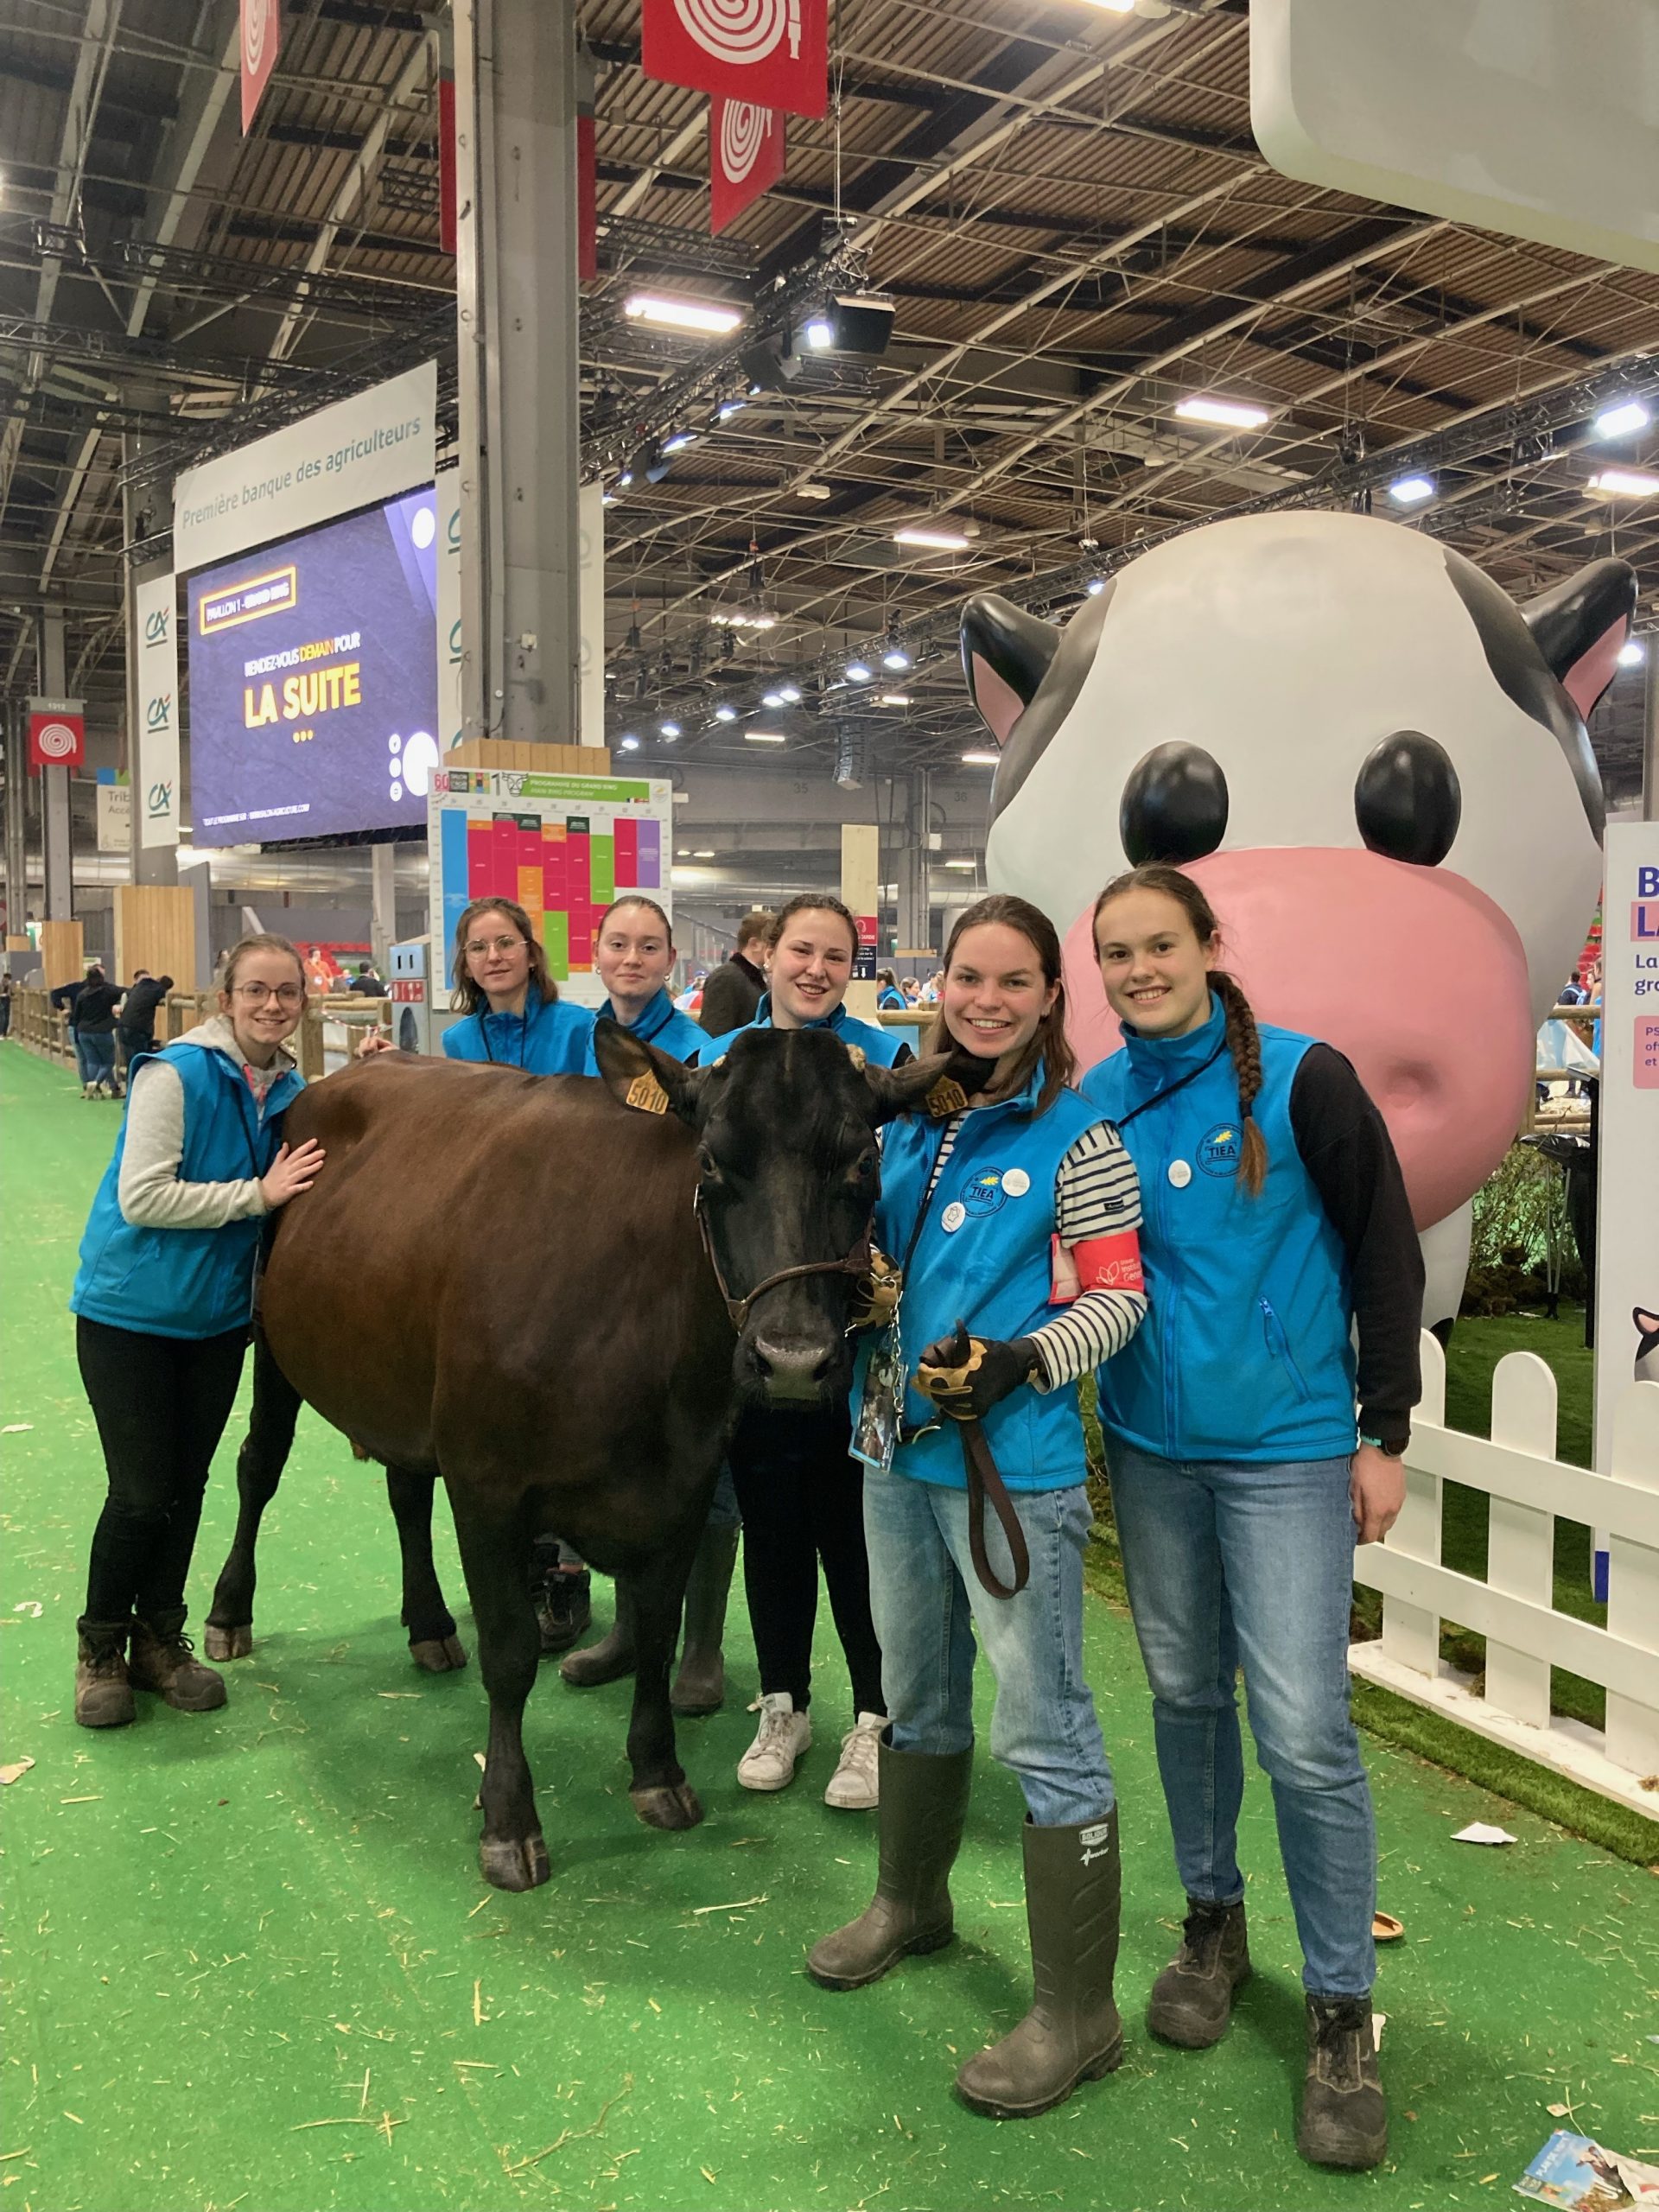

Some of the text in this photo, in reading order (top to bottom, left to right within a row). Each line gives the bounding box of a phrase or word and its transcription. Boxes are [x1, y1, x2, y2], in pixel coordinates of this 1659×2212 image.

[182, 416, 421, 529] Première banque des agriculteurs
[245, 632, 361, 677] RENDEZ-VOUS DEMAIN POUR
[245, 662, 361, 728] LA SUITE
[793, 783, 809, 794] 35
[954, 791, 968, 802] 36
[1645, 1058, 1657, 1066] et
[628, 1084, 666, 1112] 5010
[928, 1089, 965, 1116] 5010
[1210, 1146, 1236, 1158] TIEA
[972, 1185, 995, 1199] TIEA
